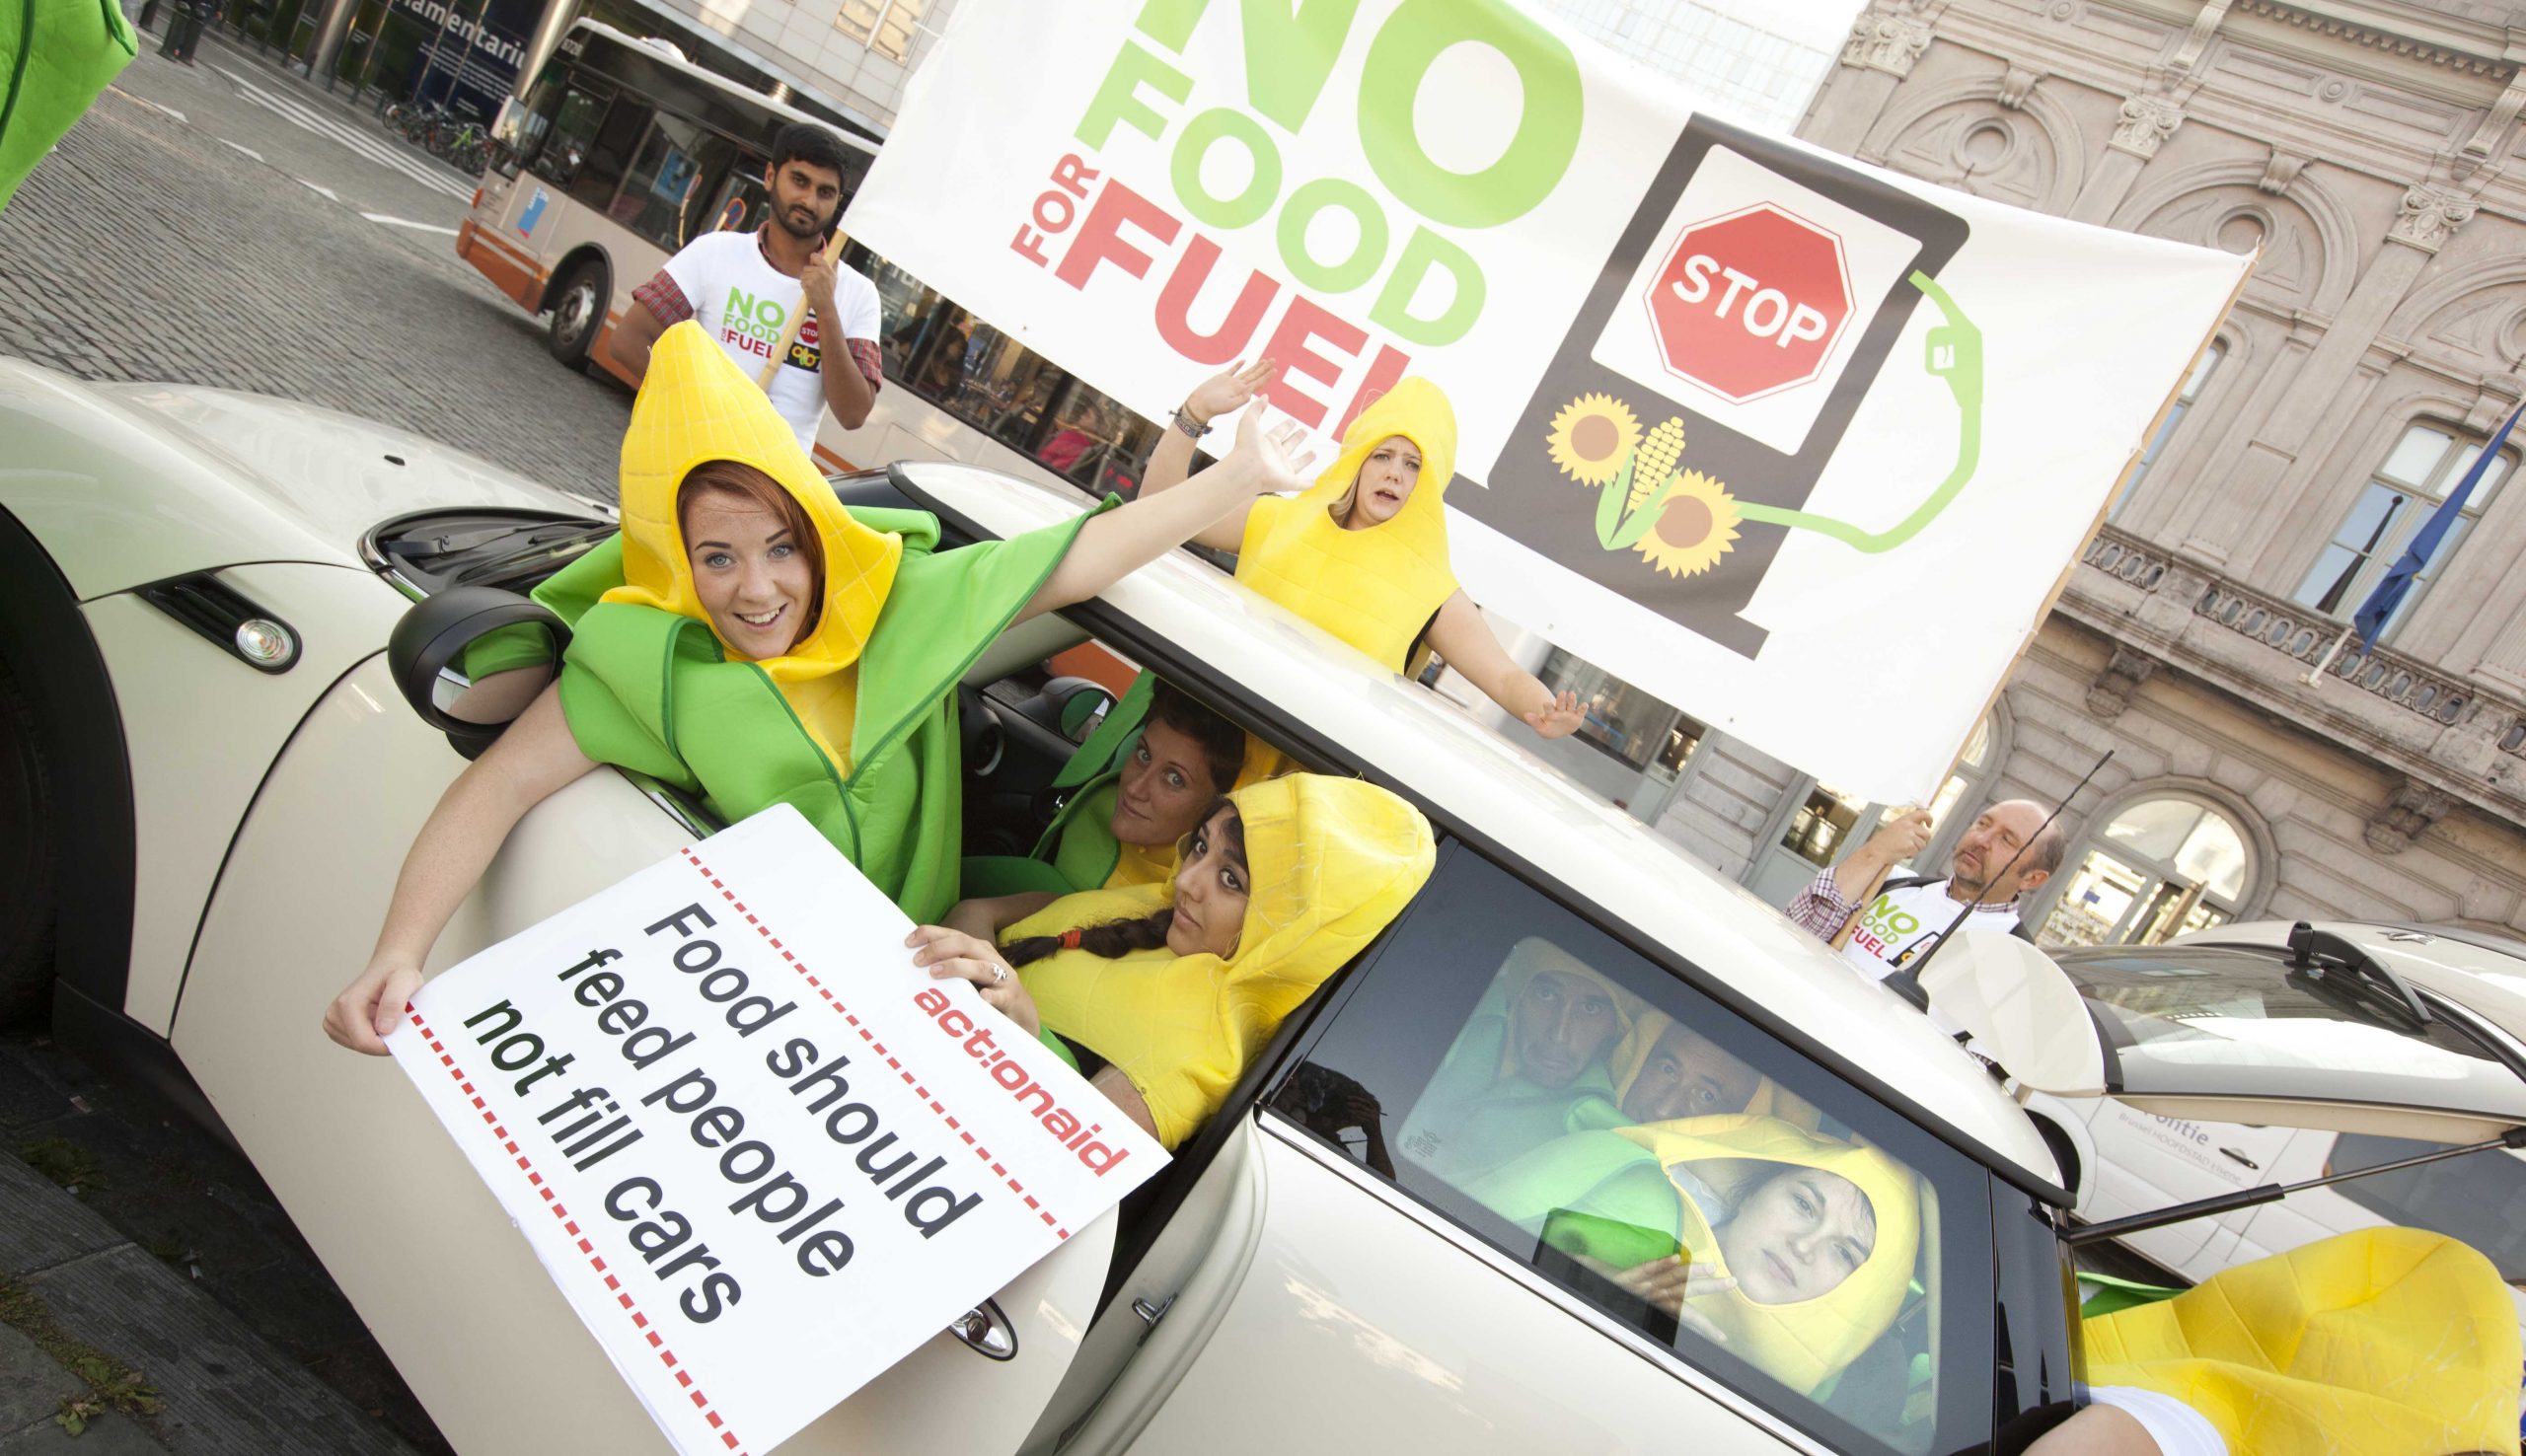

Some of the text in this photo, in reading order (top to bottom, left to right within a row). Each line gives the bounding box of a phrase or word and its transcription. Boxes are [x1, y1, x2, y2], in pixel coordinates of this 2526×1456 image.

[1009, 153, 1100, 268] FOR
[1074, 38, 1487, 347] FOOD
[722, 313, 780, 344] FOOD
[726, 285, 786, 328] NO
[1672, 254, 1828, 349] STOP
[1861, 913, 1899, 945] OOD
[1864, 894, 1919, 934] NO
[557, 948, 855, 1278] feed people
[642, 902, 984, 1241] Food should
[462, 997, 743, 1325] not fill cars
